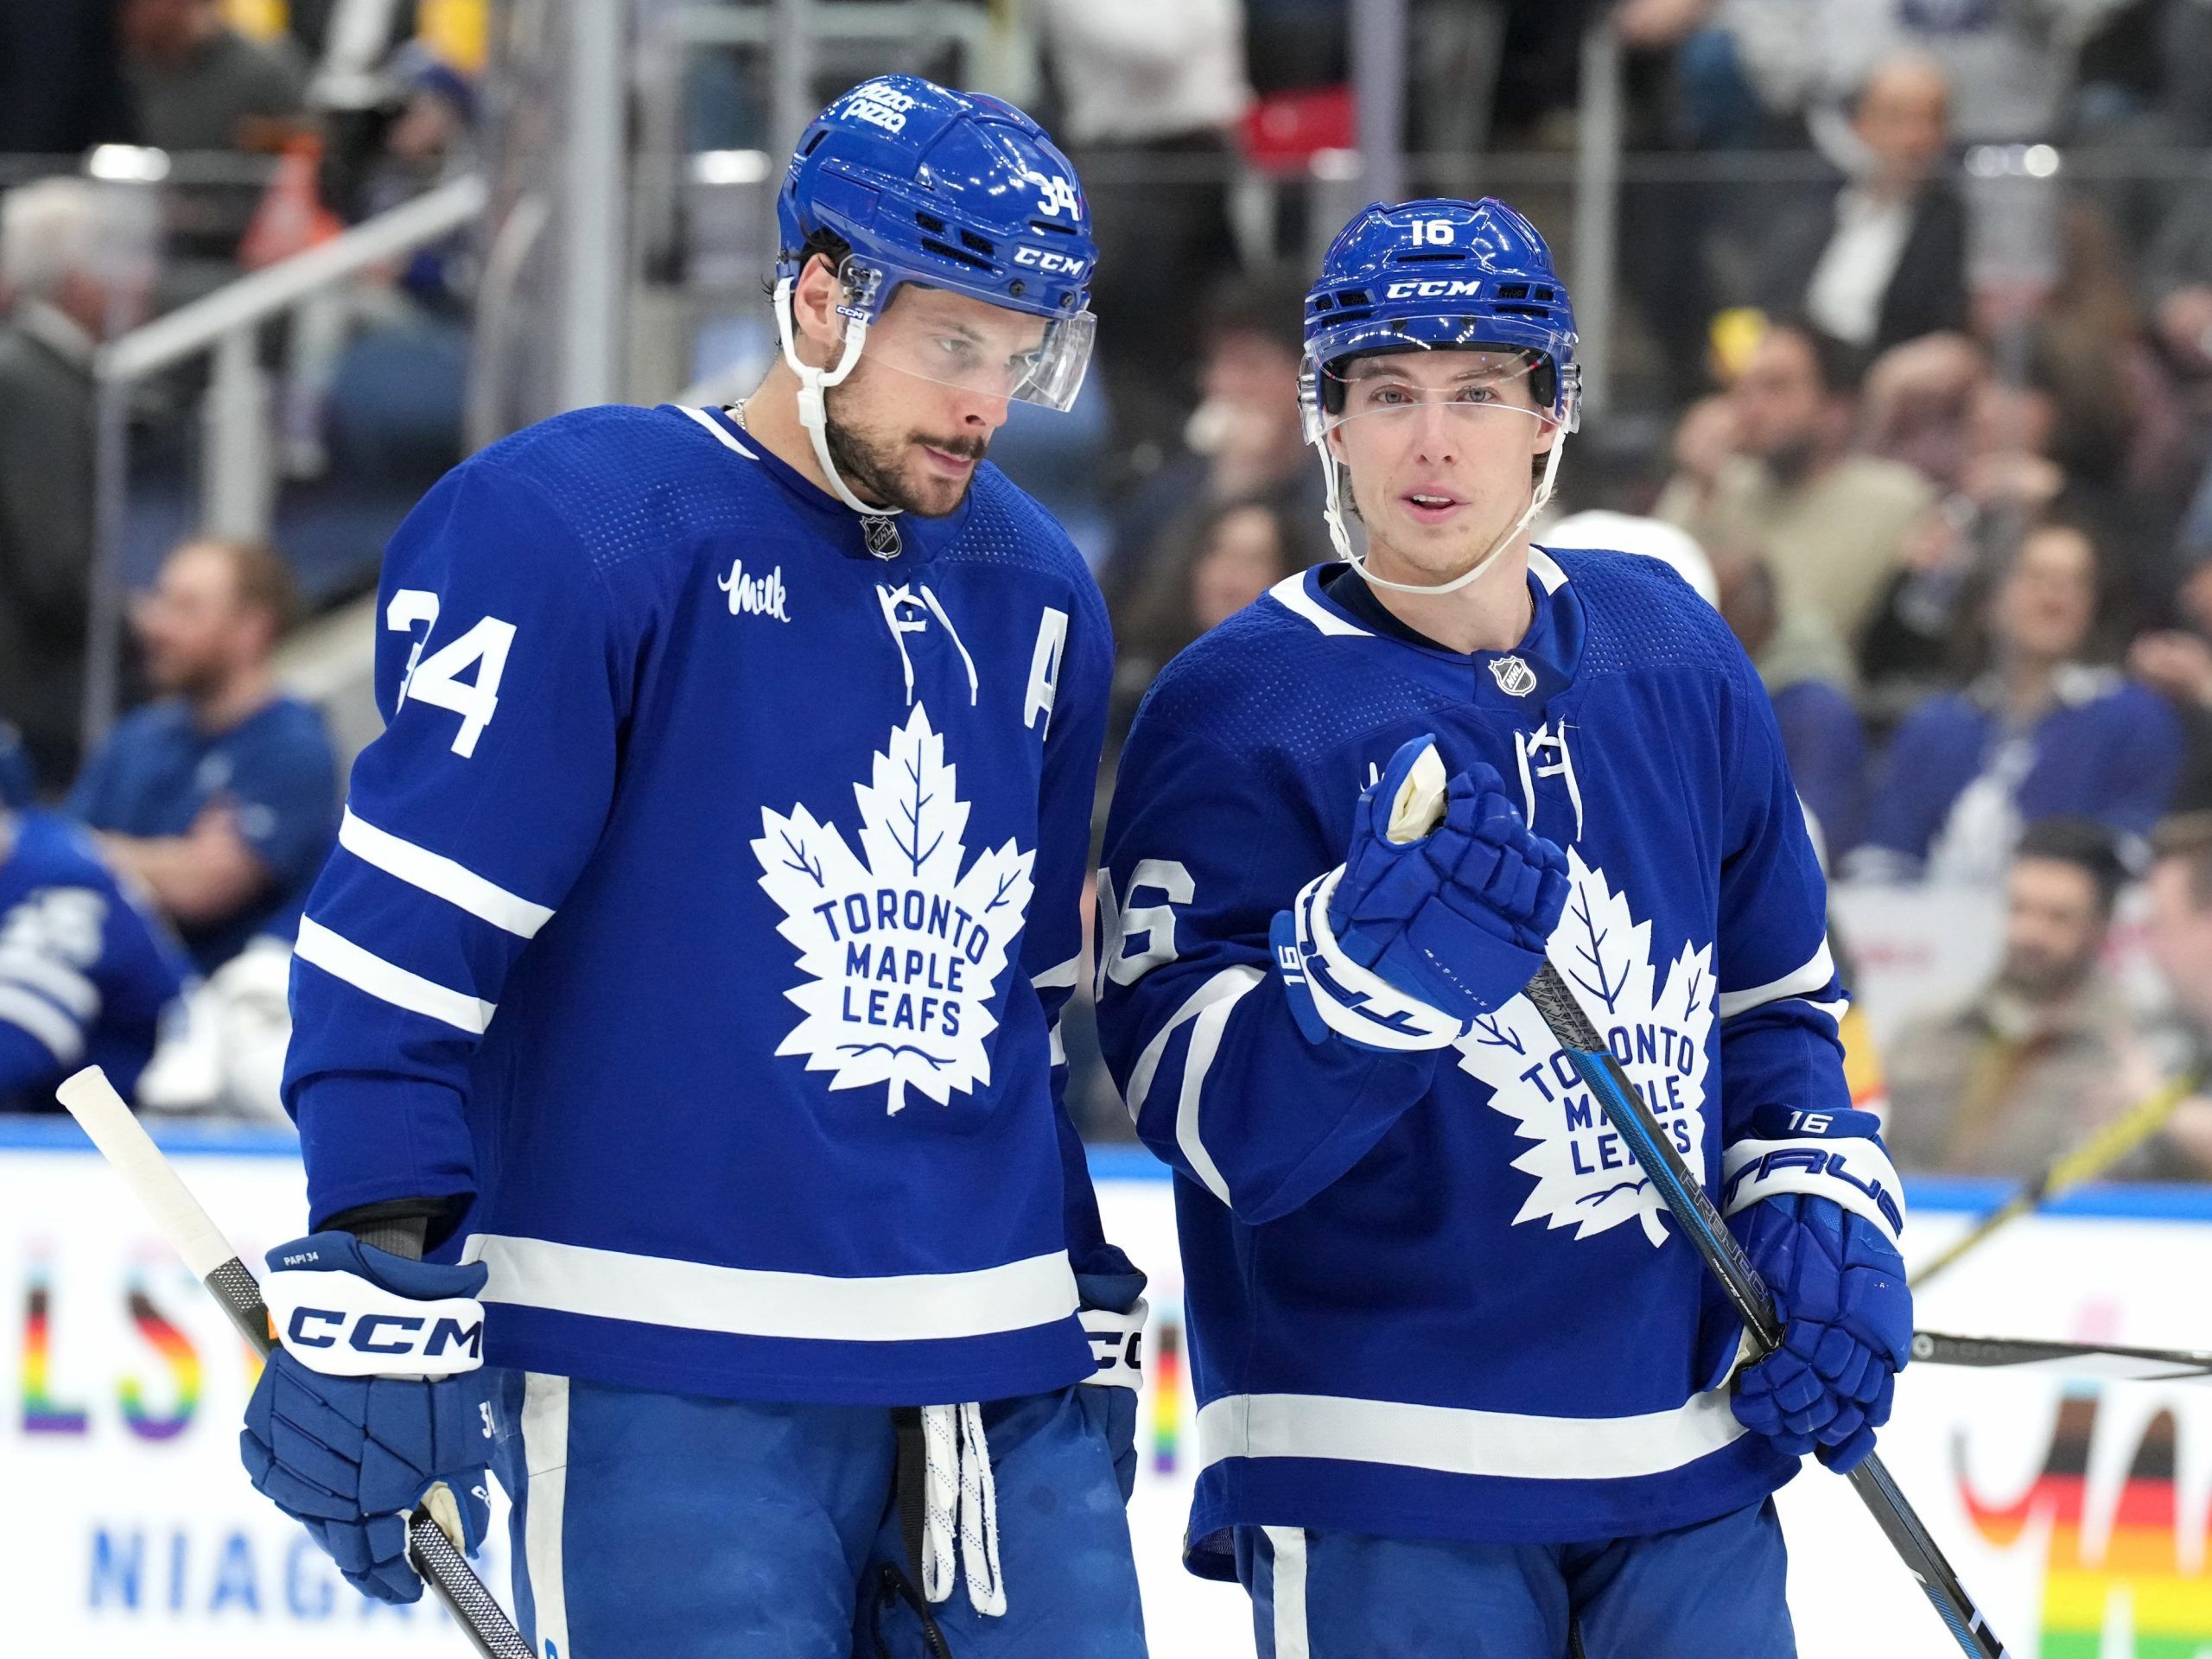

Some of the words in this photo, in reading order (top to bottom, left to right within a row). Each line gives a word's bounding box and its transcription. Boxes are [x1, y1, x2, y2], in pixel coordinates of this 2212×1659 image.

[841, 99, 906, 133] pizza
[1037, 175, 1079, 221] 34
[1412, 219, 1454, 246] 16
[1014, 247, 1084, 275] CCM
[1387, 281, 1481, 299] CCM
[837, 306, 863, 319] CCM
[874, 527, 892, 549] NHL
[718, 559, 791, 623] Milk
[1024, 607, 1068, 741] A
[1506, 664, 1522, 689] NHL
[813, 889, 989, 965] TORONTO
[846, 941, 965, 993] MAPLE
[1278, 945, 1306, 987] 16
[842, 986, 961, 1037] LEAFS
[1520, 1026, 1694, 1103] TOONTO
[1564, 1075, 1684, 1133] MLE
[1787, 1109, 1834, 1134] 16
[1571, 1119, 1691, 1176] LES
[283, 1254, 306, 1266] PAPI
[306, 1251, 319, 1262] 34
[288, 1306, 483, 1358] CCM
